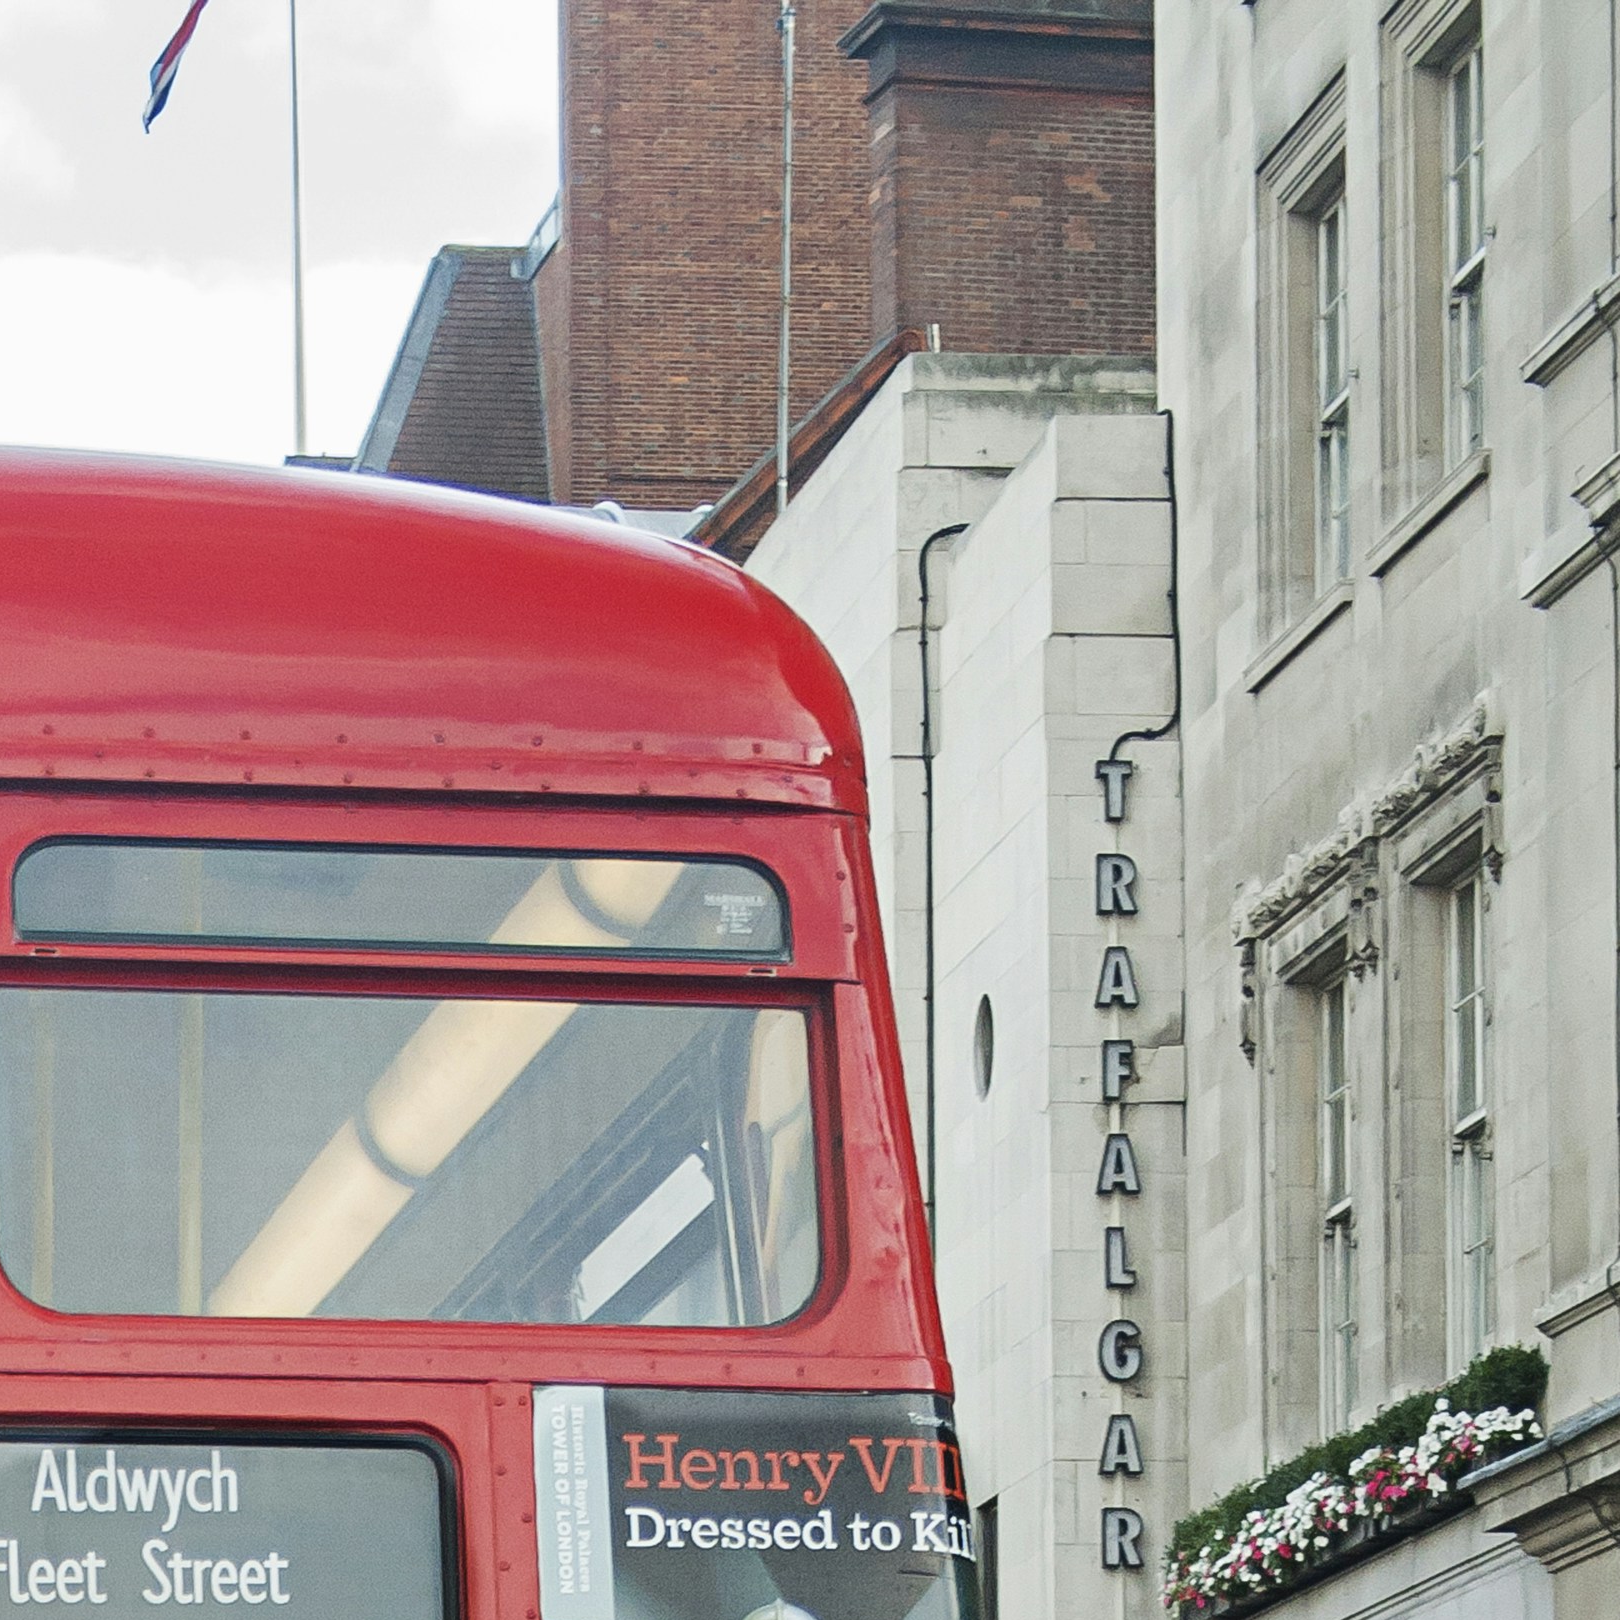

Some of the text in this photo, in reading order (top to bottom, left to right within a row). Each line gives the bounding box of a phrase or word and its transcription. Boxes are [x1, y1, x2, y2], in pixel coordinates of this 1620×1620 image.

[1093, 759, 1145, 1570] TRAFALGAR
[30, 1449, 239, 1532] Aldwych
[551, 1404, 574, 1595] TOWER OF LONDON
[622, 1433, 845, 1505] Henry
[624, 1507, 838, 1550] Dressed
[846, 1512, 902, 1551] to
[141, 1539, 291, 1605] Street
